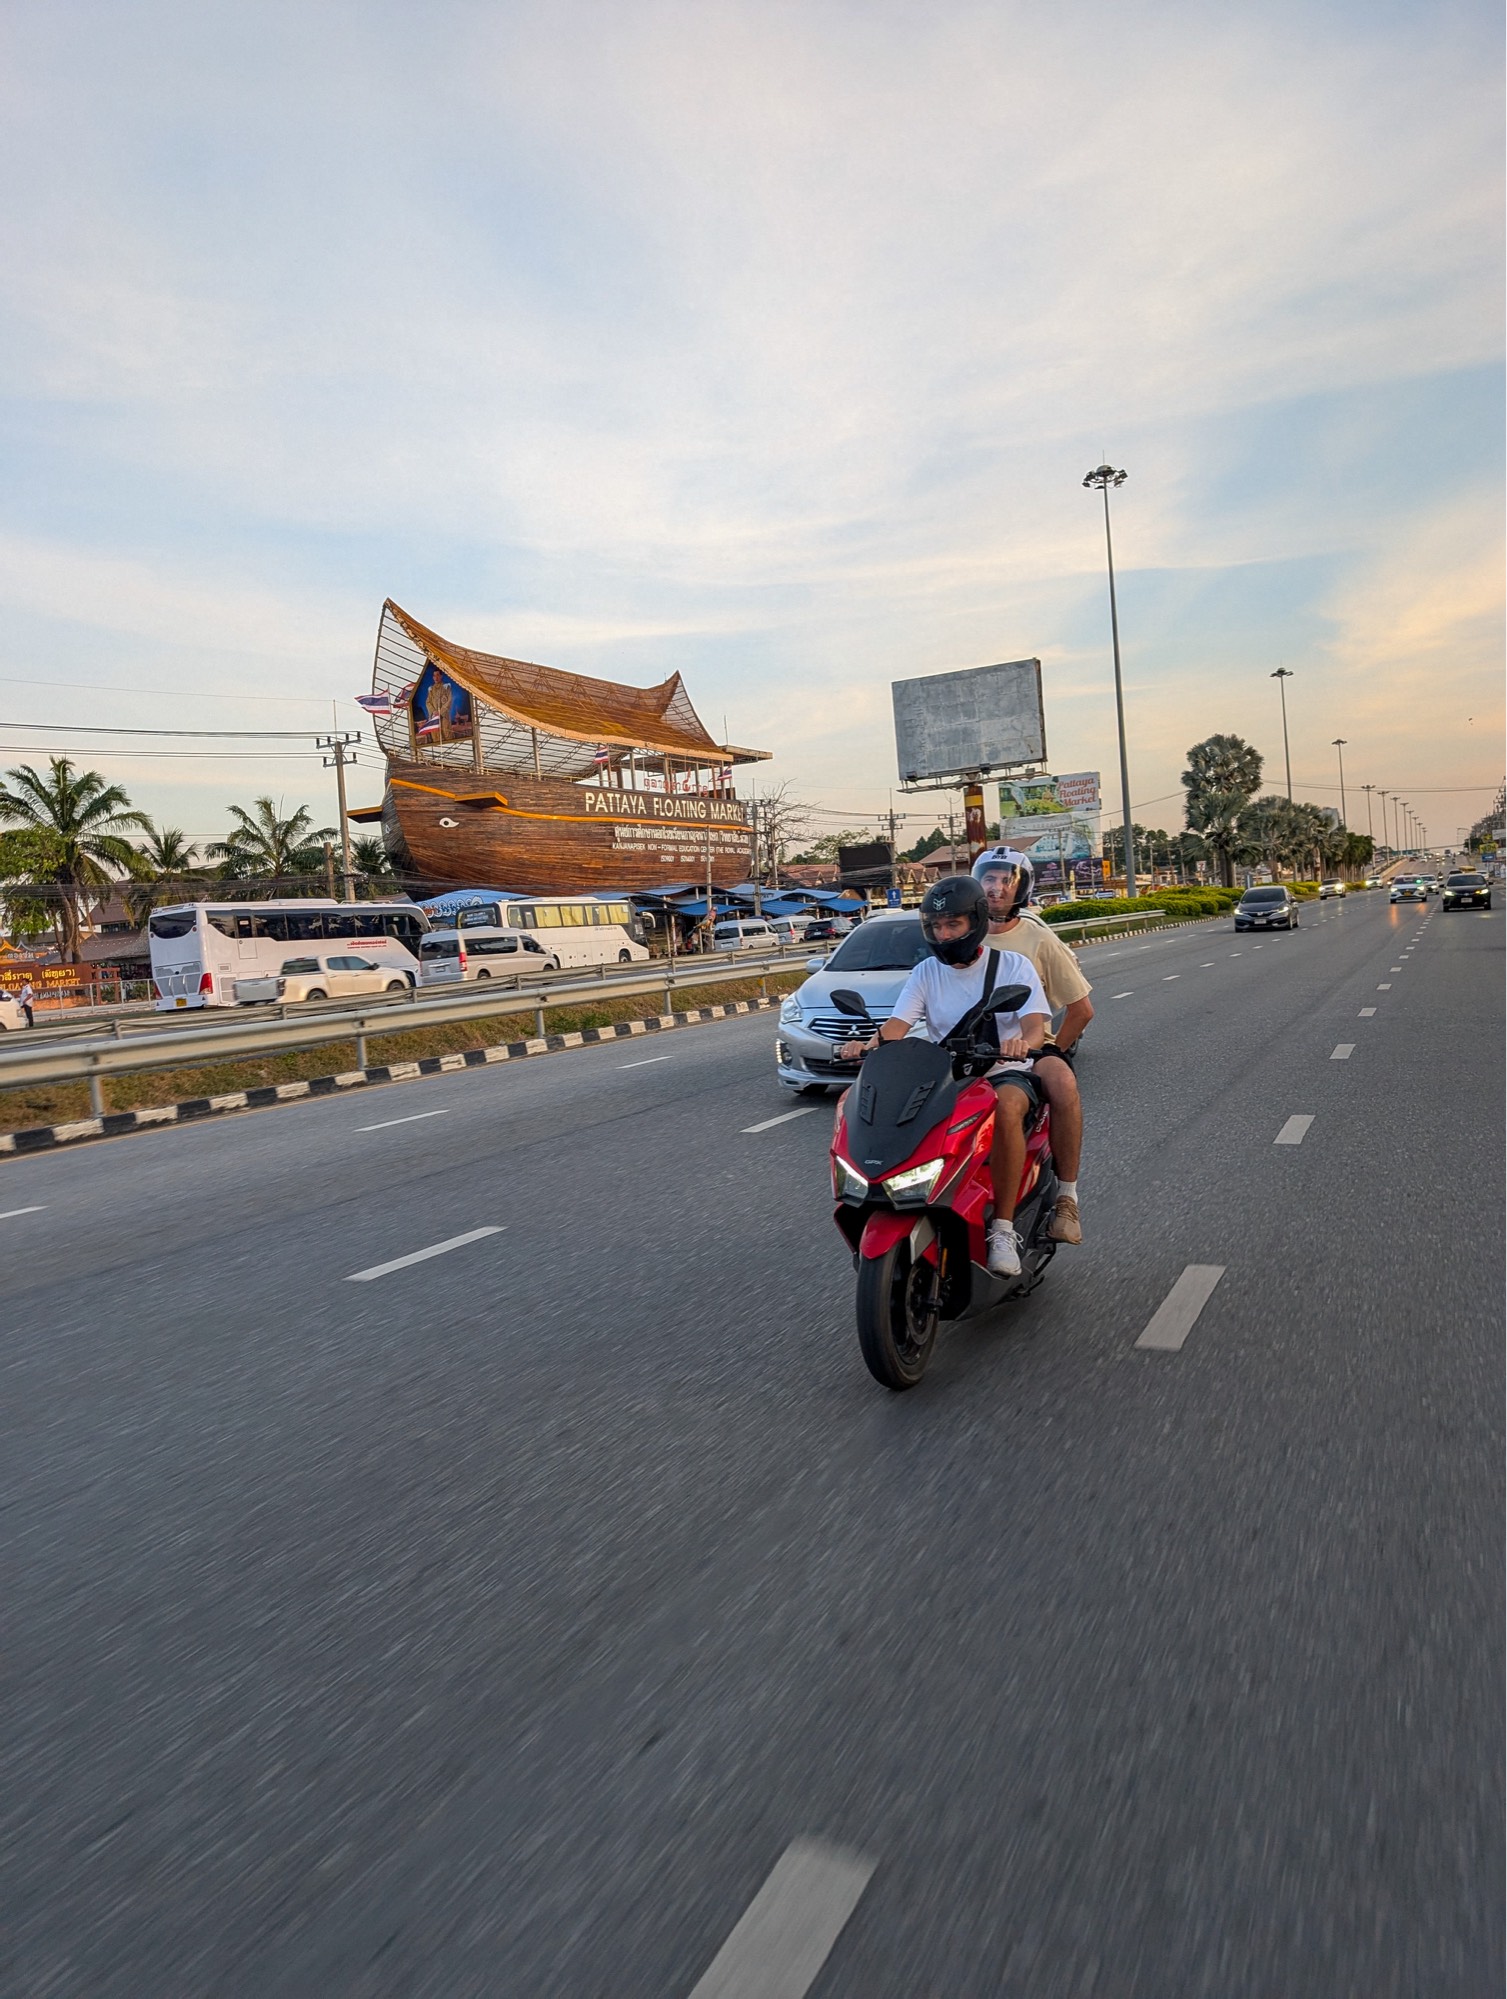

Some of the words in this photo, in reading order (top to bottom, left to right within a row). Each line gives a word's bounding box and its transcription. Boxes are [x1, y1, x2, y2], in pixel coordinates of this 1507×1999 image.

[1058, 778, 1094, 788] Pattaya
[1059, 787, 1095, 798] Floating
[1064, 795, 1095, 806] Market
[585, 792, 647, 815] PATTAYA
[653, 797, 707, 819] FLOATING
[710, 802, 744, 823] MARKET
[46, 978, 81, 988] MARKET
